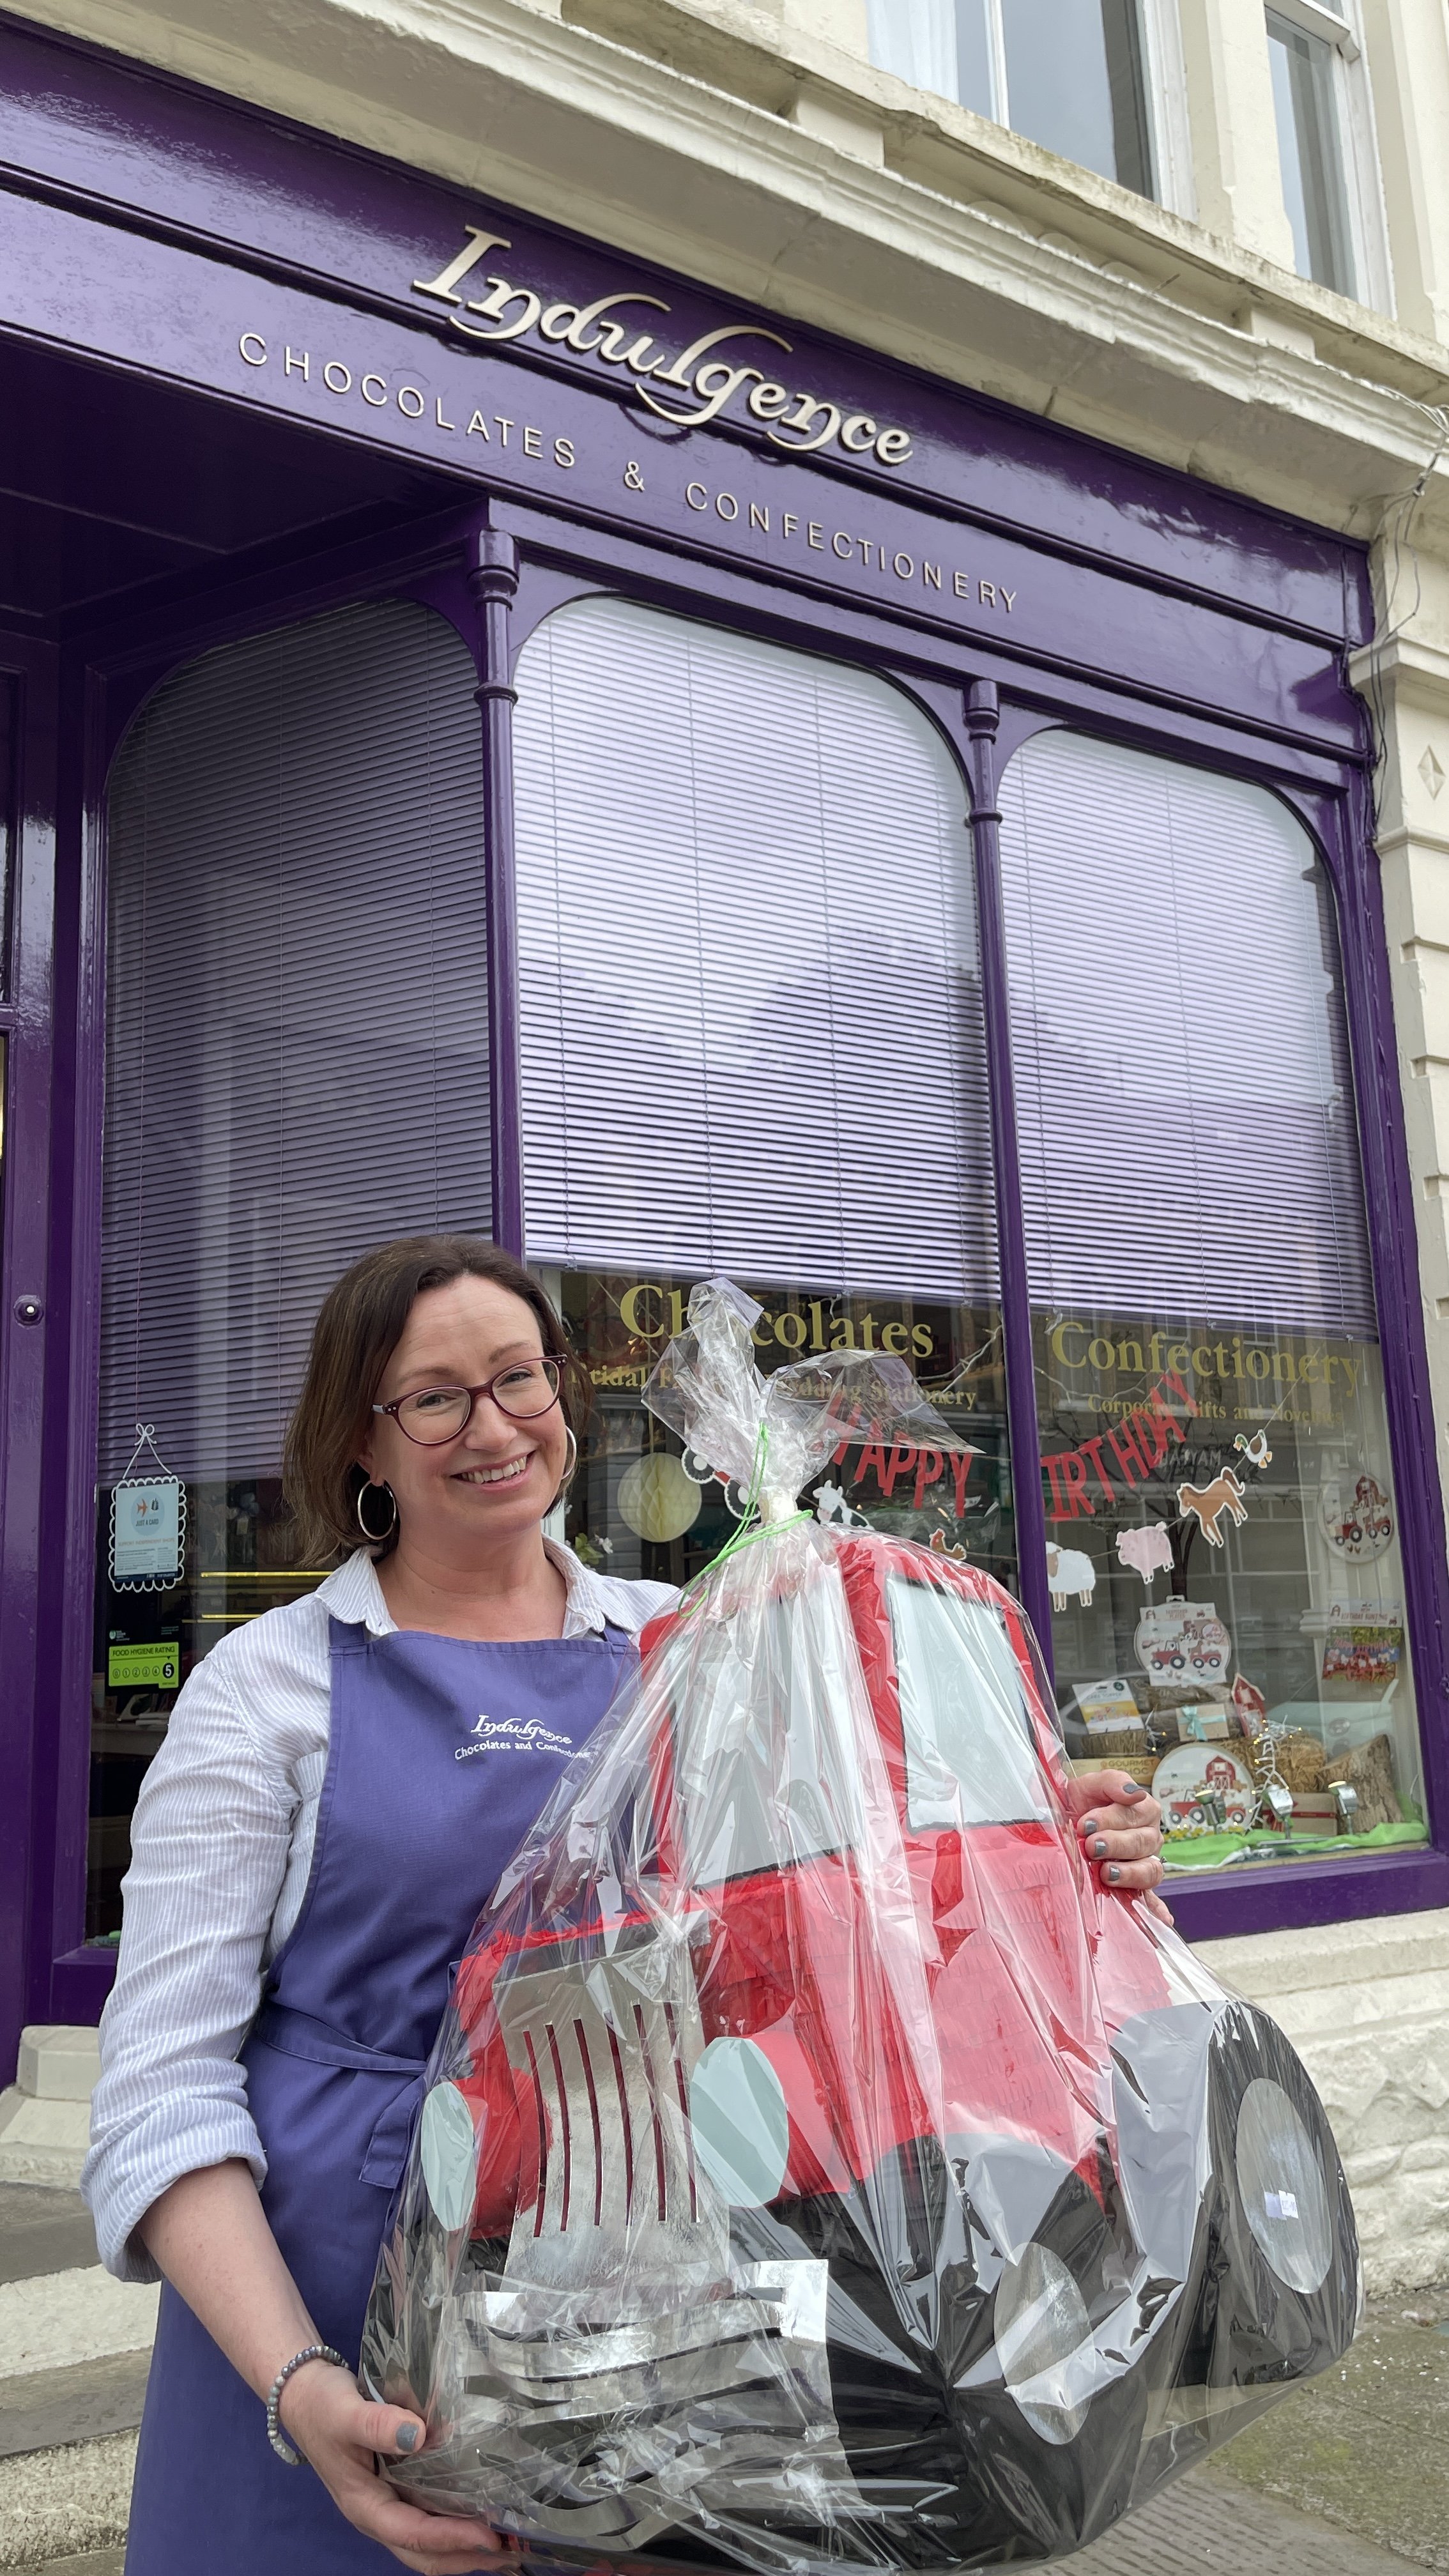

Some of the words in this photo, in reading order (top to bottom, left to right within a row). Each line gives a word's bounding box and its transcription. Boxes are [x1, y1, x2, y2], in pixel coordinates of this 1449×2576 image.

[413, 225, 914, 465] Indulgence
[239, 333, 576, 468] CHOCOLATES
[624, 461, 646, 492] &
[685, 482, 1018, 613] CONFECTIONERY
[619, 1284, 933, 1358] Chcolates
[1052, 1321, 1361, 1397] Confectionery
[1040, 1368, 1201, 1523] IRTHDAY
[165, 1664, 172, 1677] 5
[454, 1740, 511, 1761] Chocolates
[514, 1741, 533, 1751] and
[470, 1714, 572, 1744] Indulgence
[1108, 1759, 1154, 1767] GOURMET
